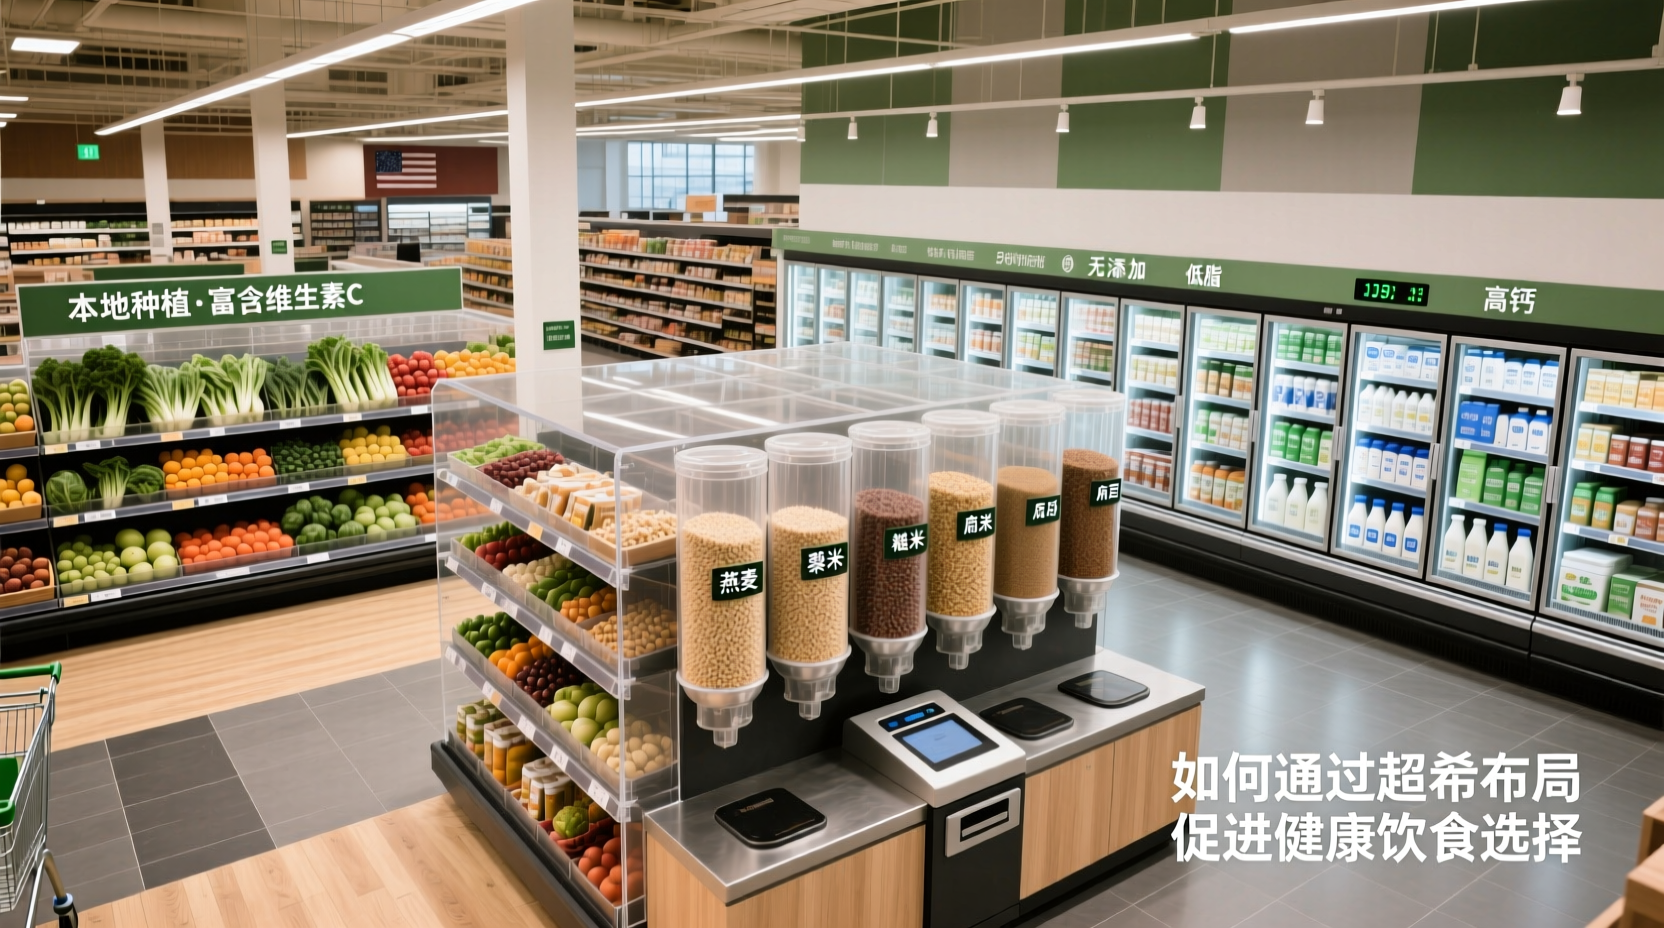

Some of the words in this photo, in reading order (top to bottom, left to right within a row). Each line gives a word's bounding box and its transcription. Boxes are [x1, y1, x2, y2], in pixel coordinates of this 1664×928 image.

[1088, 255, 1146, 280] 无添加
[1185, 263, 1222, 288] 低脂
[68, 281, 364, 323] 本地种植·富含维生素C
[1483, 285, 1537, 315] 高钙
[720, 567, 763, 595] 燕麦
